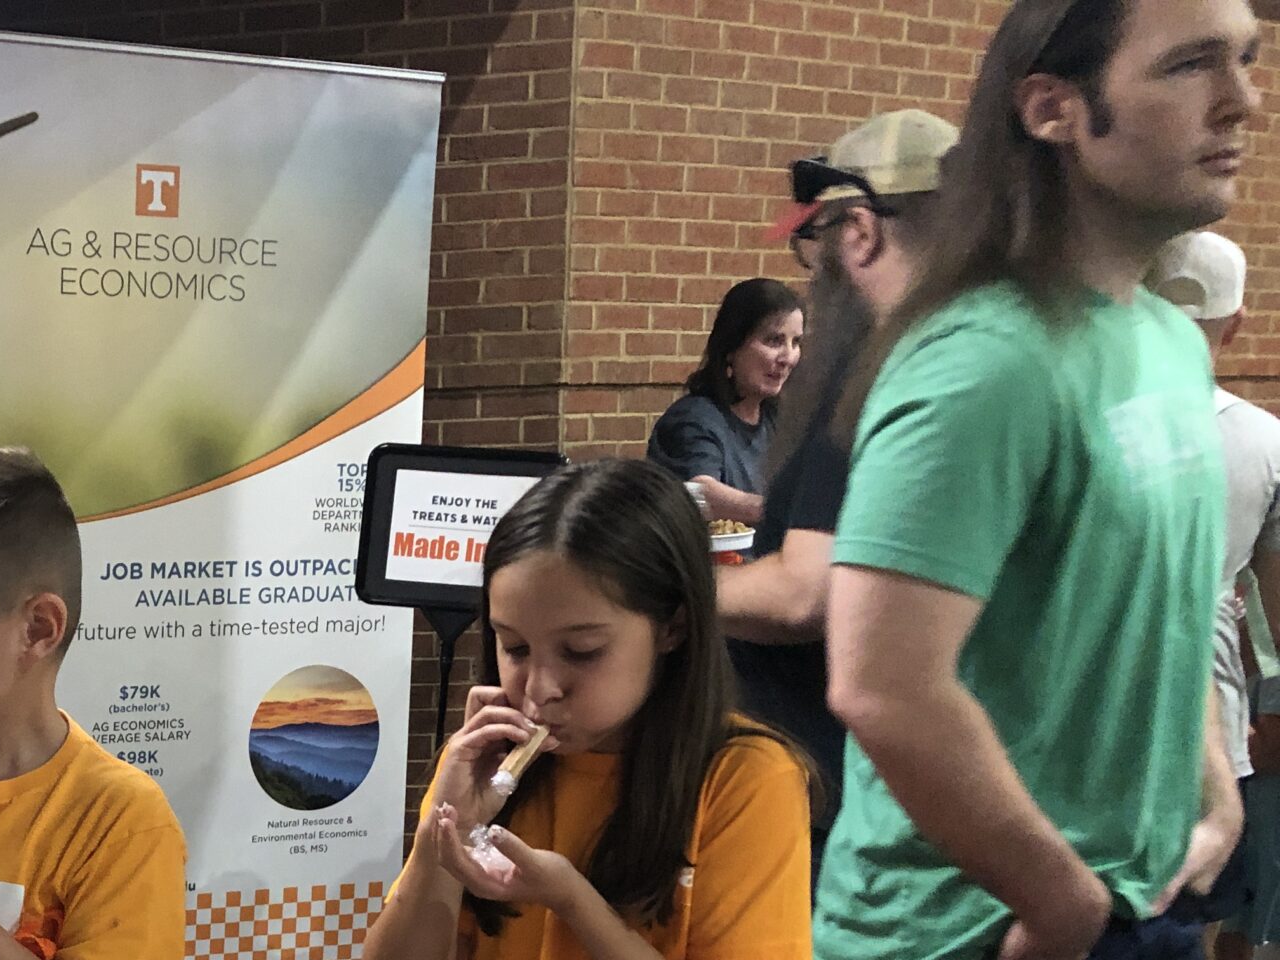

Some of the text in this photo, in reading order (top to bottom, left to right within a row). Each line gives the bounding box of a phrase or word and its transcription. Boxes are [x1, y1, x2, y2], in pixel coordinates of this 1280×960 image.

[140, 169, 176, 212] T
[25, 226, 279, 268] AG & RESOURCE
[60, 266, 247, 303] ECONOMICS
[314, 496, 365, 509] WORLD
[431, 494, 498, 511] ENJOY THE
[312, 509, 363, 522] DEPART
[411, 510, 500, 527] TREATS & WAT
[323, 521, 361, 533] RANKI
[392, 530, 461, 562] Made
[100, 558, 357, 582] JOB MARKET IS OUTPACI
[134, 584, 356, 608] AVAILABLE GRADUAT
[76, 615, 387, 642] future with a time-tested major!
[119, 684, 161, 701] $79K
[108, 702, 170, 715] (bachelor's)
[92, 718, 185, 733] AG ECONOMICS
[92, 730, 192, 744] VERAGE SALARY
[267, 815, 354, 829] Natural Resource &
[251, 828, 368, 844] Environmental Economics
[289, 843, 328, 855] (BS, MS)
